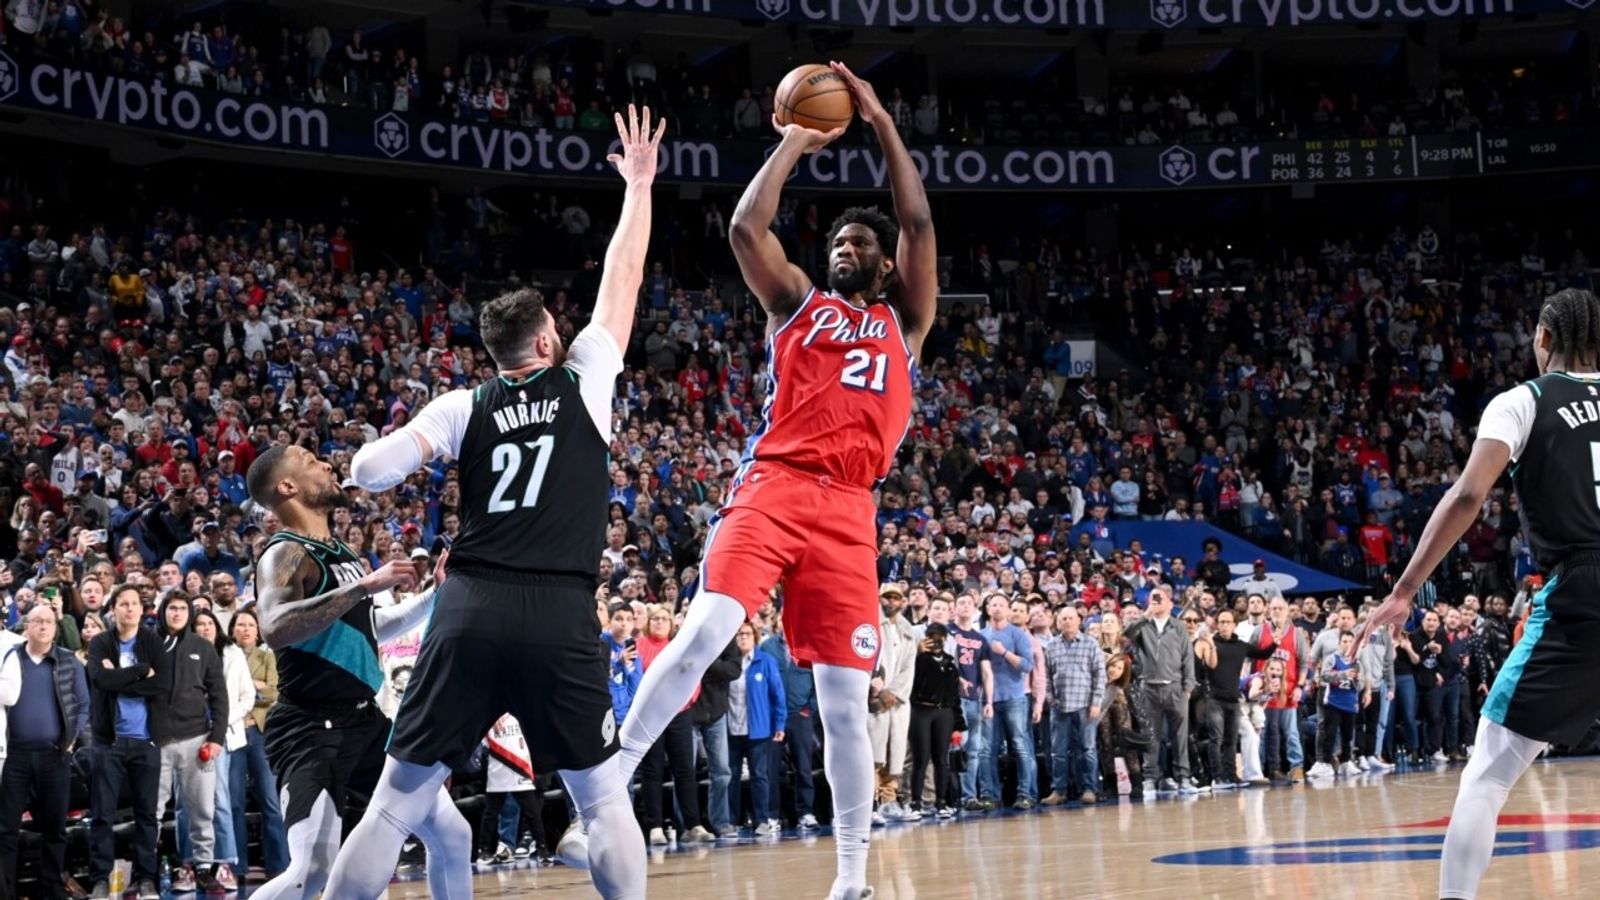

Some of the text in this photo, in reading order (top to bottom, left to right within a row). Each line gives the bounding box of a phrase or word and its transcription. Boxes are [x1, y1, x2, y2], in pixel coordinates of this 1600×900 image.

[30, 62, 328, 148] crypto.com
[1333, 139, 1350, 149] AST
[1420, 147, 1474, 161] 9:28 PM
[1486, 138, 1508, 149] TOR
[1207, 146, 1260, 180] cr
[1272, 150, 1400, 166] PHI 42 25 4 7
[1488, 154, 1507, 165] LAL
[1271, 164, 1402, 181] POR 36 24 3 6
[802, 305, 888, 348] Phila
[840, 348, 888, 392] 21
[493, 396, 561, 434] NURKIĆ
[1557, 400, 1600, 429] RED
[58, 471, 65, 482] 0
[487, 434, 554, 514] 27
